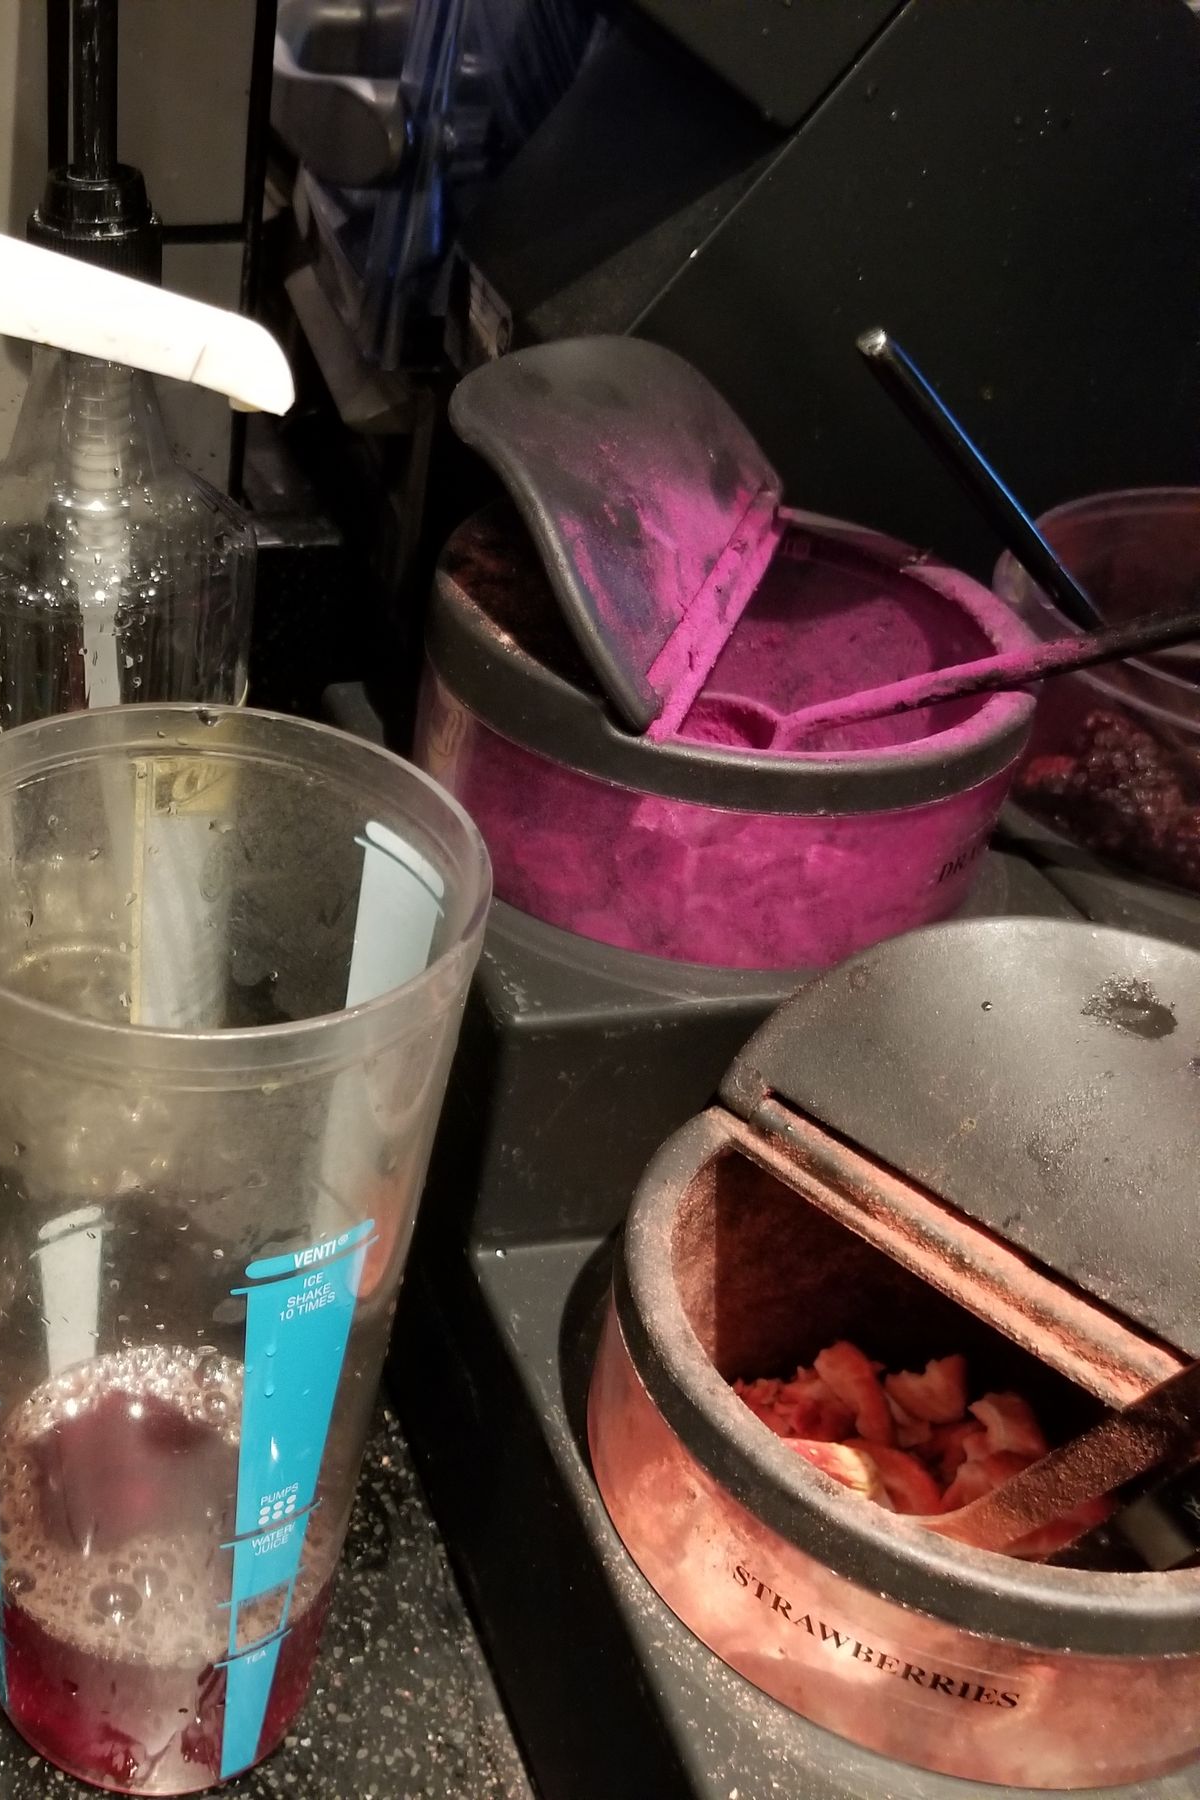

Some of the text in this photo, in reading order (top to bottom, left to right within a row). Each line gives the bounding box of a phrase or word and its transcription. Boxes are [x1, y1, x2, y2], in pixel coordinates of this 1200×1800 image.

[303, 1271, 324, 1289] ICE
[279, 1291, 336, 1321] 10 TIMES
[286, 1281, 331, 1309] SHAKE
[260, 1482, 299, 1506] PUMPS
[254, 1534, 288, 1557] JUICE
[731, 1564, 1021, 1710] STRAWBERRIES
[246, 1649, 267, 1665] TEA
